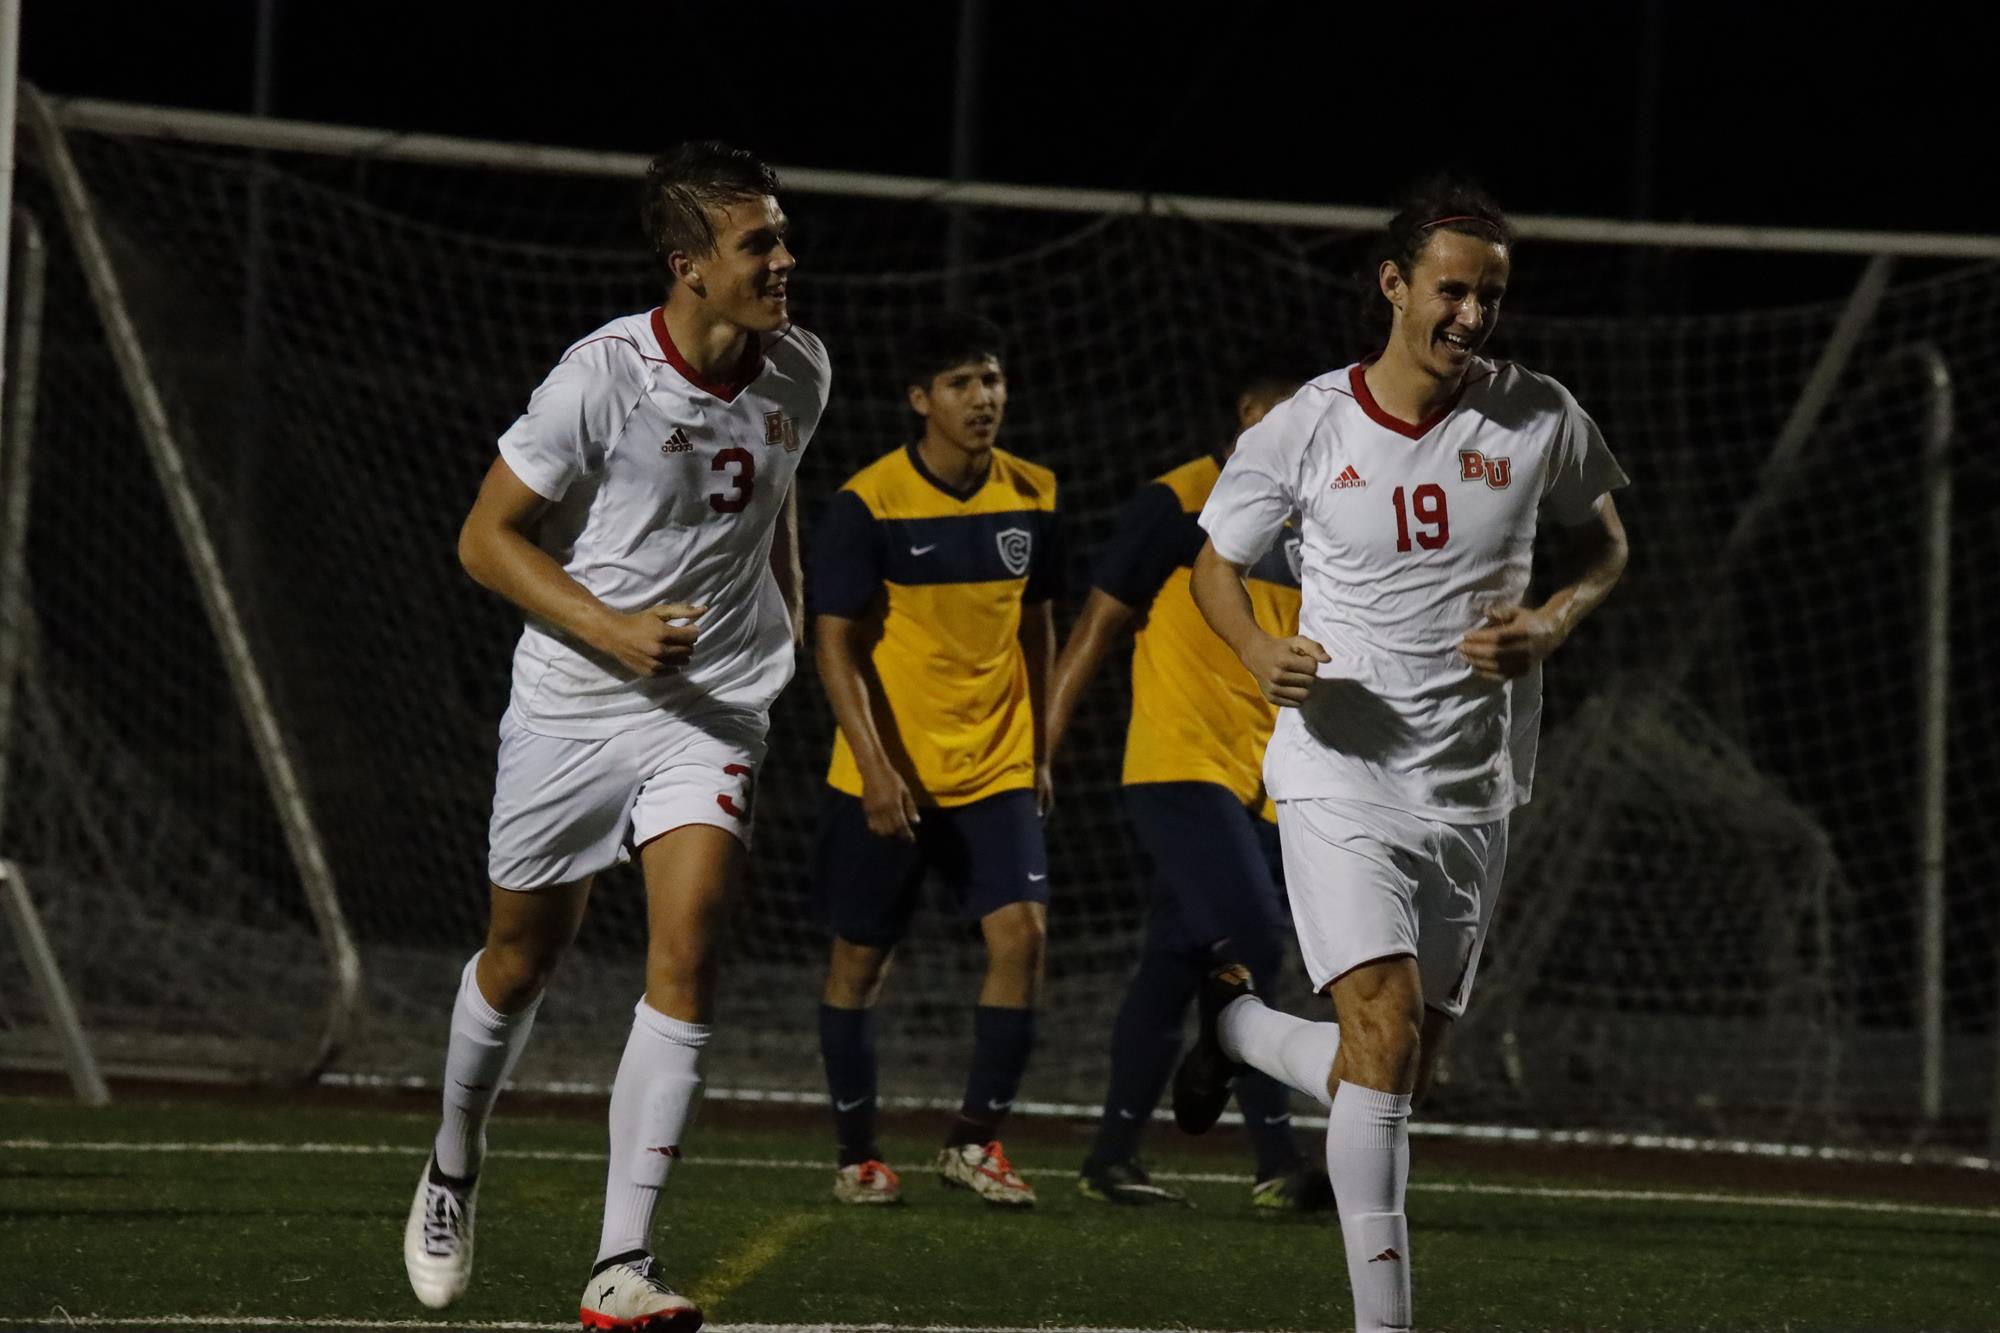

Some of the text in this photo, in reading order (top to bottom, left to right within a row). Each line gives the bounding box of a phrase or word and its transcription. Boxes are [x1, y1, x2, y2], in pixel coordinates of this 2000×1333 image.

[661, 443, 694, 453] adidas
[1459, 449, 1511, 490] BU
[709, 447, 756, 513] 3
[1330, 478, 1367, 490] adidas
[1392, 483, 1450, 552] 19
[716, 763, 754, 823] 3
